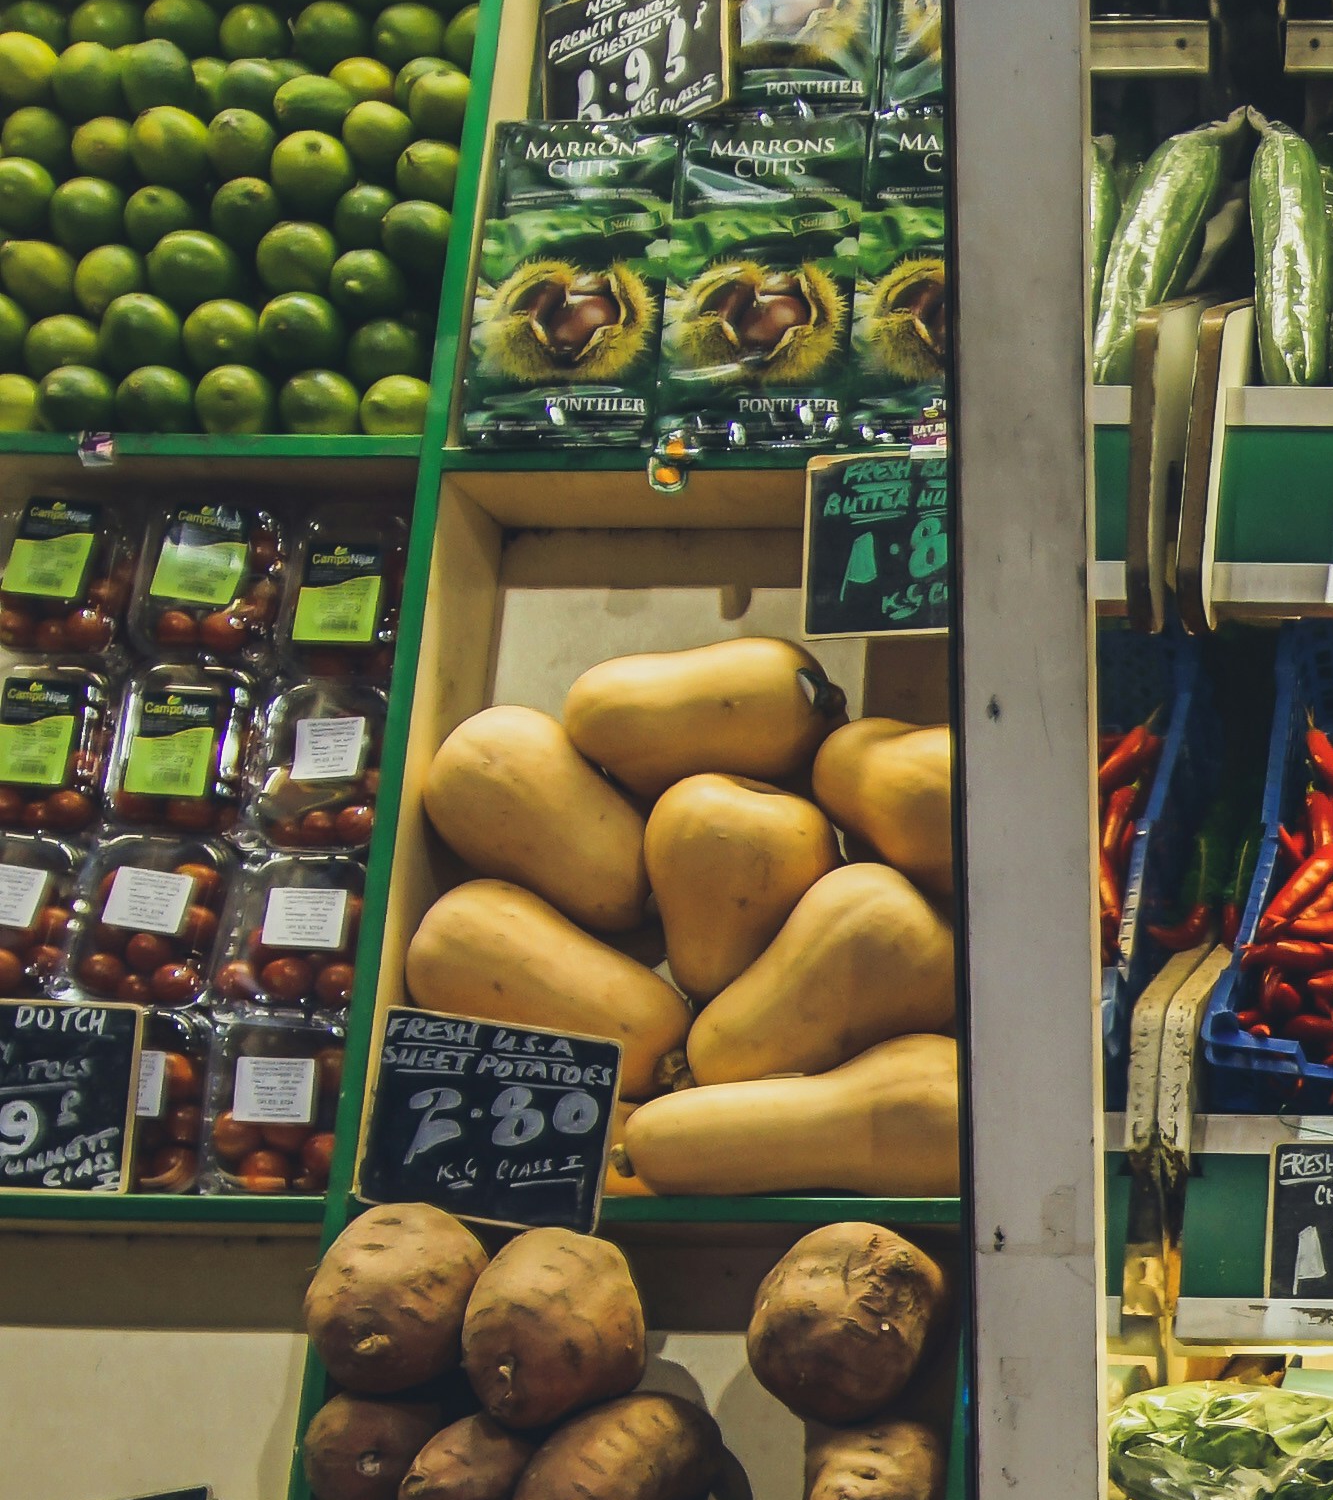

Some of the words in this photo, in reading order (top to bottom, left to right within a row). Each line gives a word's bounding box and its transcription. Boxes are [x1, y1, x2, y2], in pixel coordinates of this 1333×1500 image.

[548, 16, 613, 60] FRENCH
[766, 79, 863, 97] PONTHIER
[526, 139, 648, 159] MARRONS
[712, 138, 835, 159] MARRONS
[547, 159, 620, 180] CUITS
[734, 158, 806, 180] CUITS
[547, 397, 645, 414] PONTHIER
[739, 398, 838, 413] PONTHIER
[14, 1005, 107, 1035] DUTCH
[387, 1018, 480, 1046] FRESH
[382, 1048, 475, 1070] SWEET
[475, 1053, 613, 1086] POTATOES
[404, 1086, 599, 1165] 2.80
